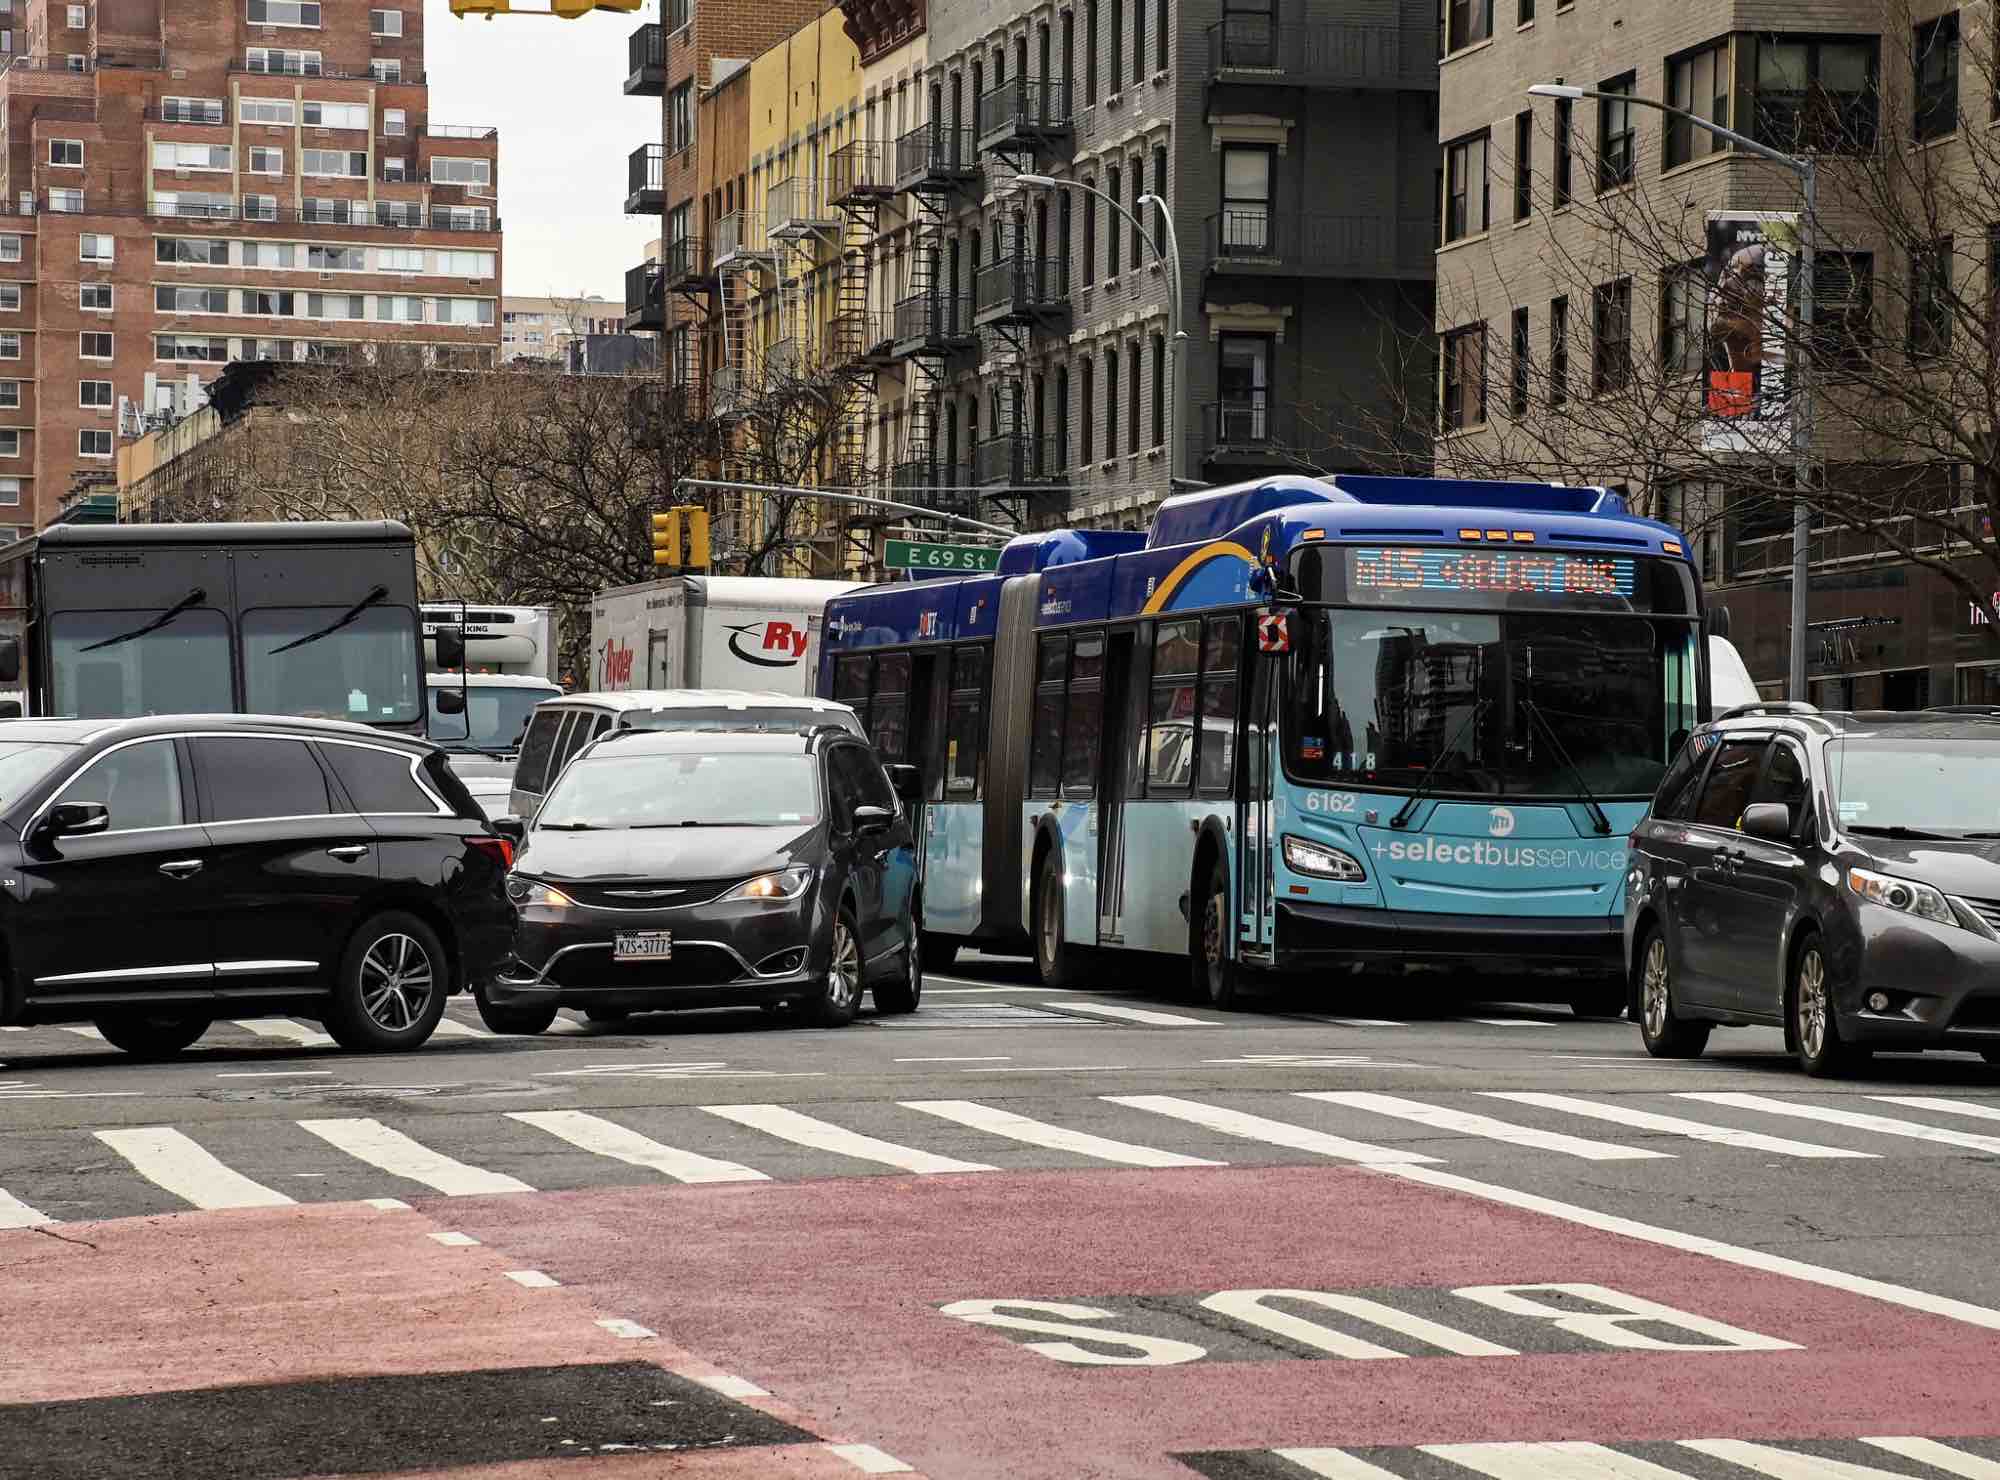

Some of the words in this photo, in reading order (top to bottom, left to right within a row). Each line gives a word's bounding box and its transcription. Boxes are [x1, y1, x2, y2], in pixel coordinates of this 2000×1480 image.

[909, 548, 921, 563] E
[928, 550, 954, 567] 69
[962, 552, 986, 570] St
[466, 624, 489, 633] KING
[762, 621, 808, 658] Ry
[1306, 792, 1356, 813] 6162
[940, 1283, 1806, 1366] BUS
